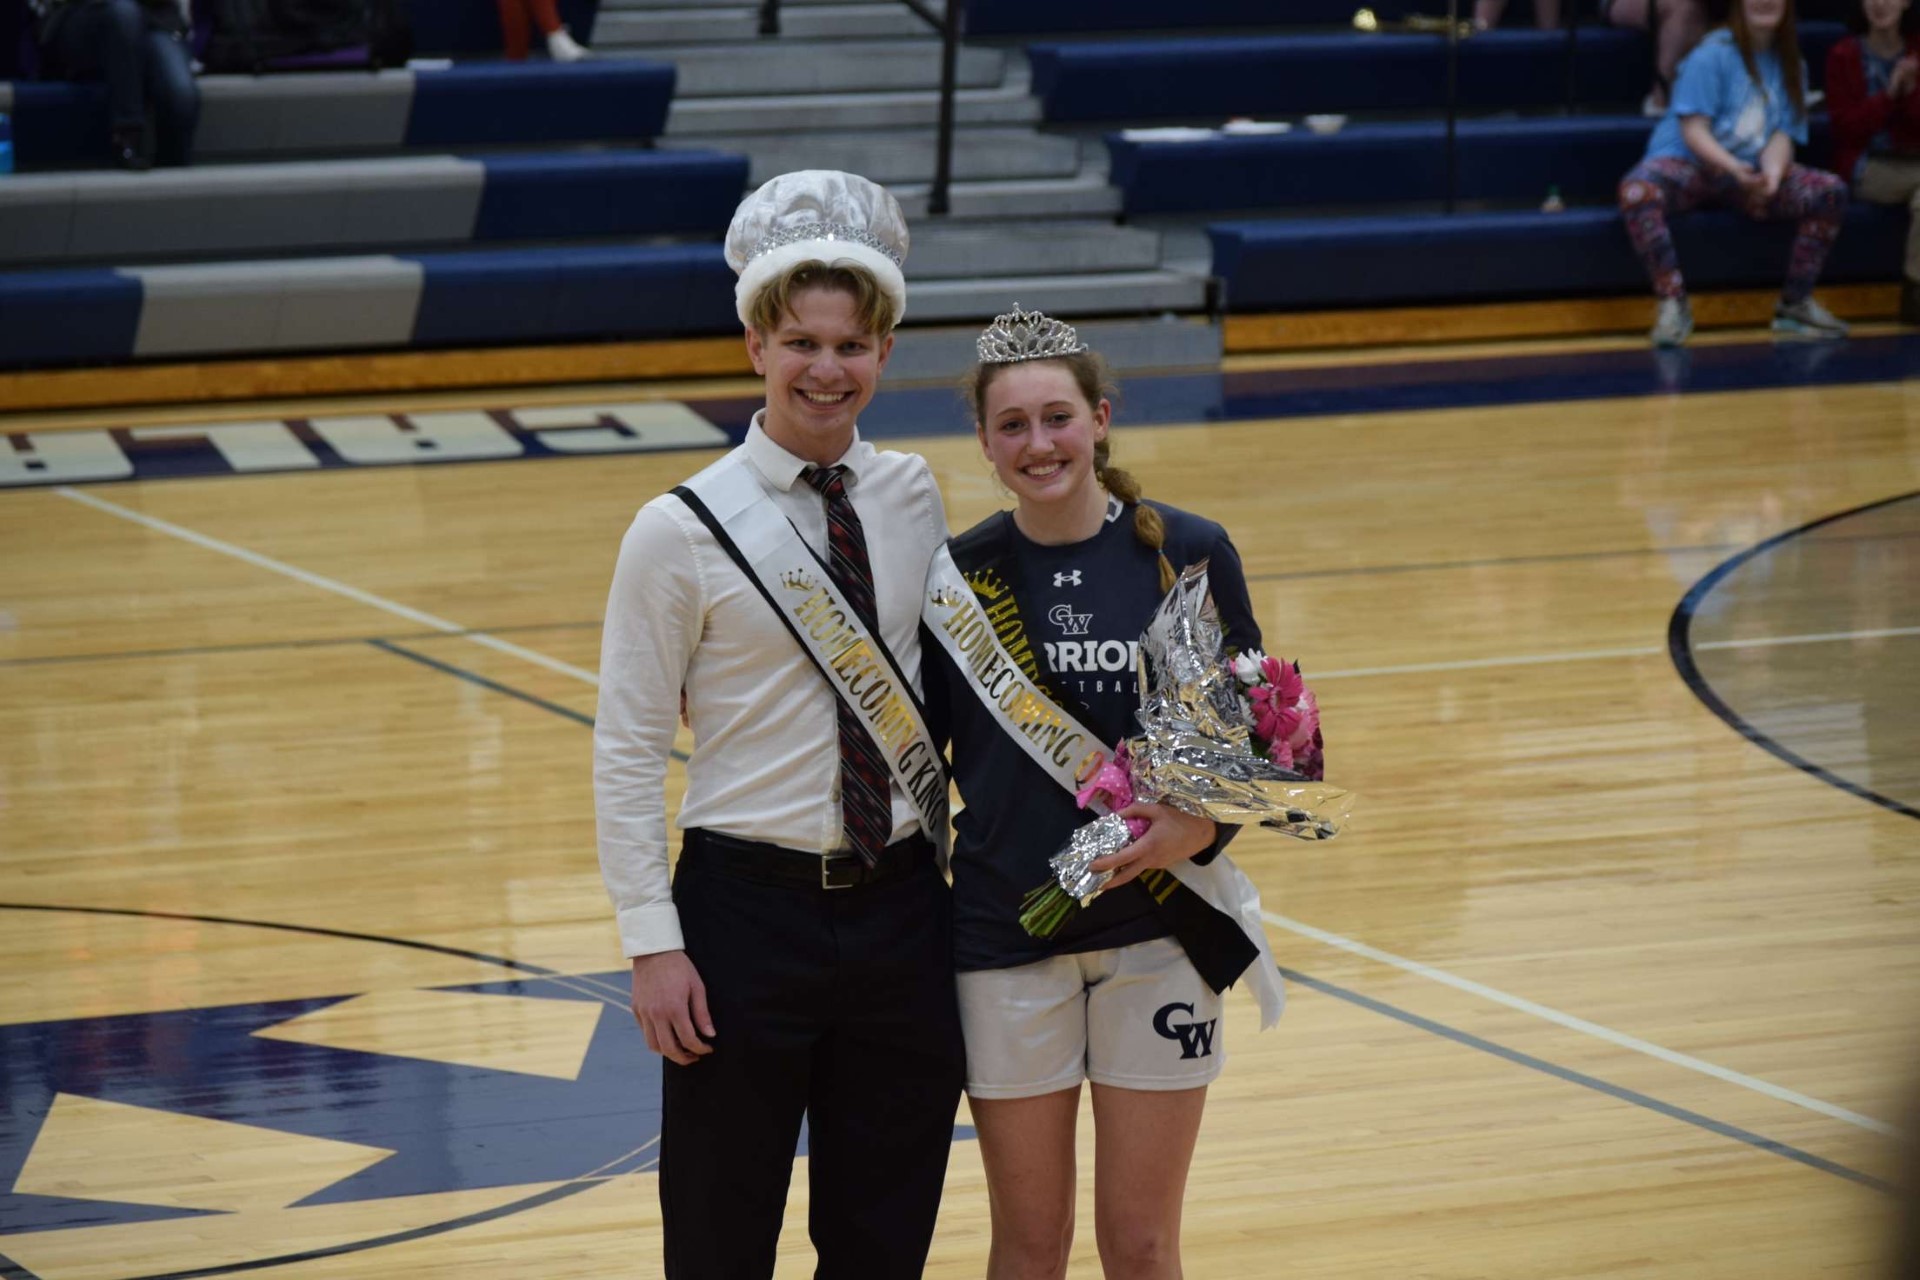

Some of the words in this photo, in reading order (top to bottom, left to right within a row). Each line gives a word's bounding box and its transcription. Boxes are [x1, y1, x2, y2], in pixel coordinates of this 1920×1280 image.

[793, 587, 926, 774] HOMECOMING
[907, 757, 945, 833] KING
[942, 600, 1085, 768] HOMECOMING
